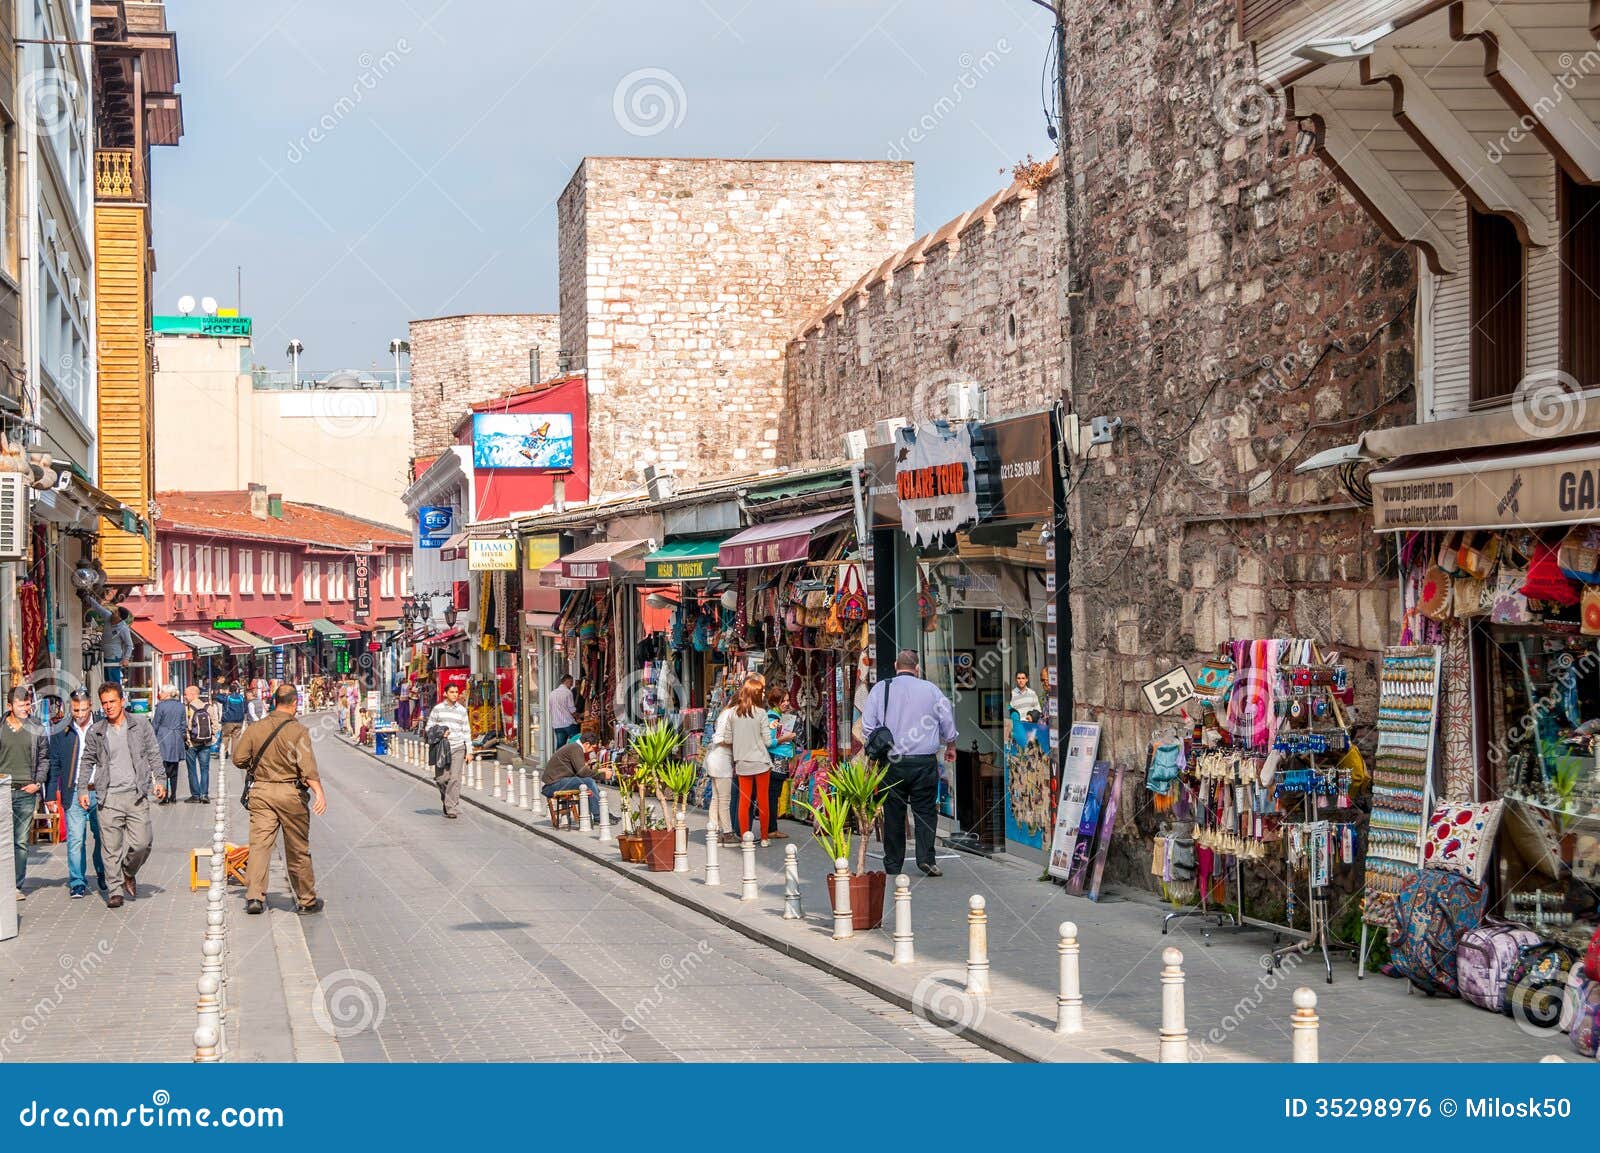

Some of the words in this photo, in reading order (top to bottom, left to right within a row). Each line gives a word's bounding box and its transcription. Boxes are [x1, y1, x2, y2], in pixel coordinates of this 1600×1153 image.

[203, 325, 249, 334] HOTEL
[936, 461, 965, 497] TOUR
[1559, 469, 1600, 511] GA
[426, 516, 447, 524] EFES
[935, 505, 955, 521] AGENCY
[472, 542, 513, 551] TIAMO
[356, 556, 368, 609] HOTEL
